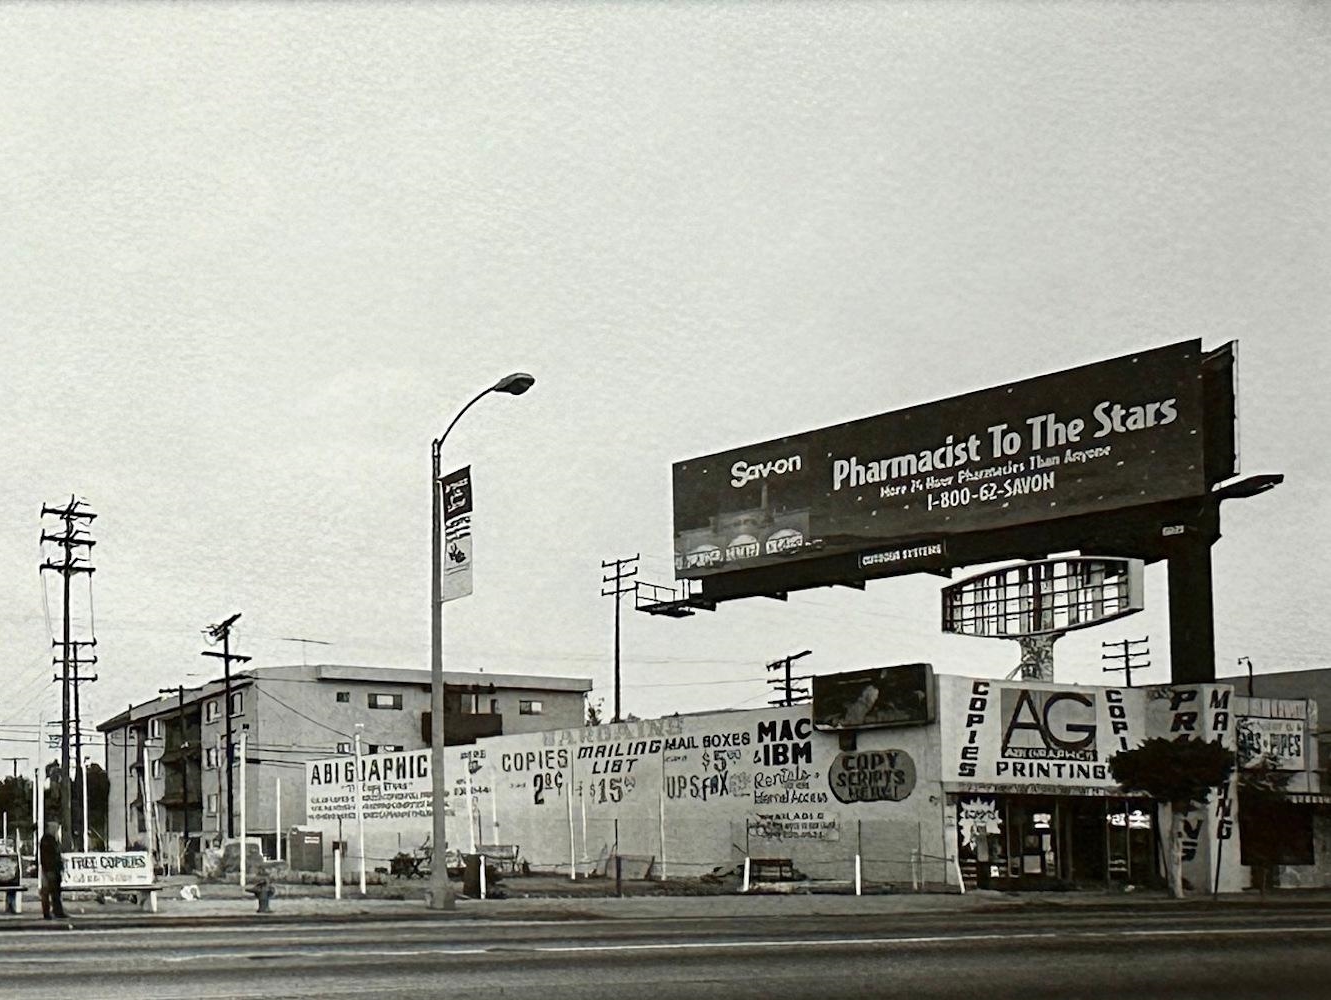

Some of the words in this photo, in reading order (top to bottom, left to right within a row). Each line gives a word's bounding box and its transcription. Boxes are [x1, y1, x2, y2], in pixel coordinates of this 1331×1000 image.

[833, 434, 981, 491] Pharmacist
[987, 423, 1022, 458] To
[1026, 412, 1085, 450] The
[1093, 398, 1178, 438] Stars
[880, 483, 907, 498] More
[926, 475, 954, 490] Hour
[957, 460, 1026, 484] Pharmacies
[1029, 454, 1061, 470] Than
[1064, 445, 1112, 464] Anyone
[927, 471, 1055, 511] 1-800-62-SAVON
[757, 718, 813, 743] MAC
[958, 681, 990, 777] COPIES
[1001, 688, 1097, 751] AG
[1105, 690, 1129, 751] COPI
[577, 740, 662, 759] MAILING
[665, 736, 699, 750] MAIL
[702, 732, 751, 748] BOXES
[763, 741, 813, 766] IBM
[502, 749, 568, 772] COPIES
[841, 752, 900, 771] COPY
[996, 761, 1106, 779] PRINTING
[1210, 690, 1233, 840] MAIING
[310, 762, 339, 785] ABI
[71, 856, 98, 869] FREE
